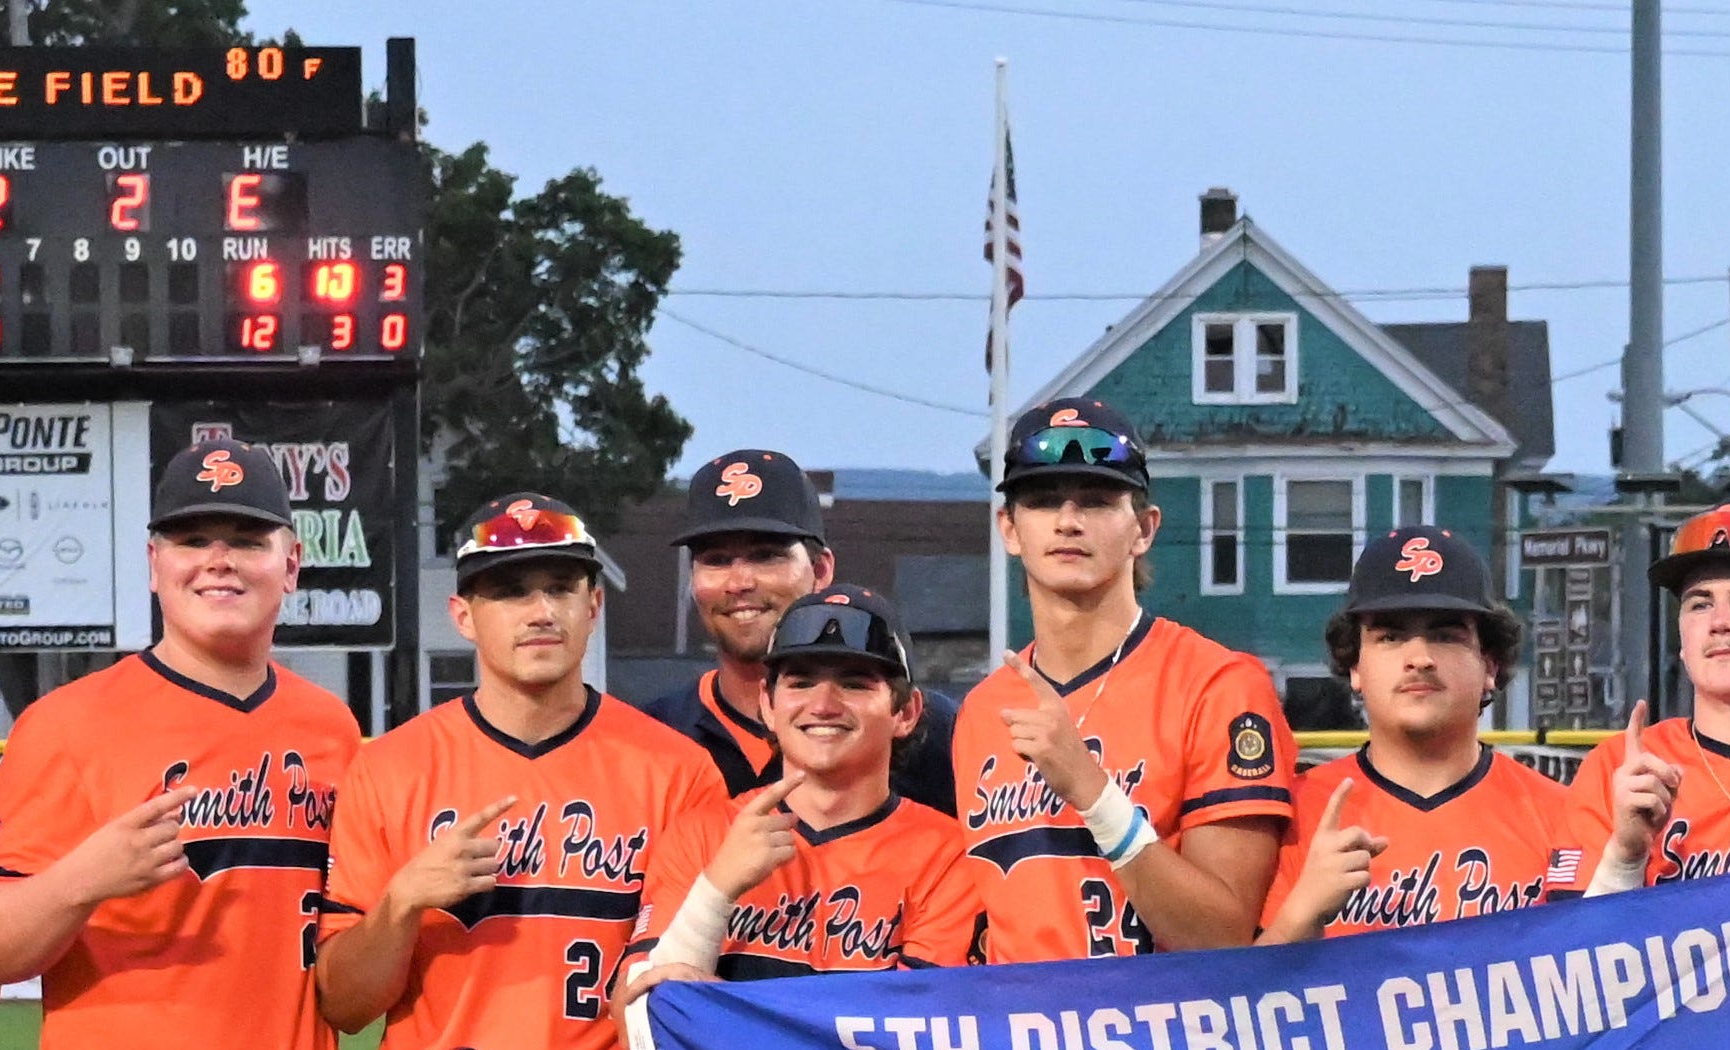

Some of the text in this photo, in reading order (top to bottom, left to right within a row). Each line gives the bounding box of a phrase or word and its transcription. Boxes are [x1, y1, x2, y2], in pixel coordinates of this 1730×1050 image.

[226, 47, 284, 80] 80
[45, 71, 204, 105] FIELD
[98, 147, 151, 170] OUT
[243, 146, 289, 169] H/E
[110, 174, 149, 231] 2
[228, 174, 262, 231] E
[26, 239, 42, 261] 7
[73, 239, 90, 261] 8
[124, 239, 141, 261] 9
[167, 239, 197, 261] 10
[223, 238, 269, 260] RUN
[308, 238, 352, 260] HITS
[370, 237, 411, 260] ERR
[249, 262, 279, 301] 6
[383, 264, 407, 301] 3
[241, 314, 279, 351] 12
[332, 314, 354, 351] 3
[381, 314, 407, 351] 0
[557, 799, 650, 885] Post
[1325, 850, 1443, 928] mith
[725, 883, 904, 961] mith Post
